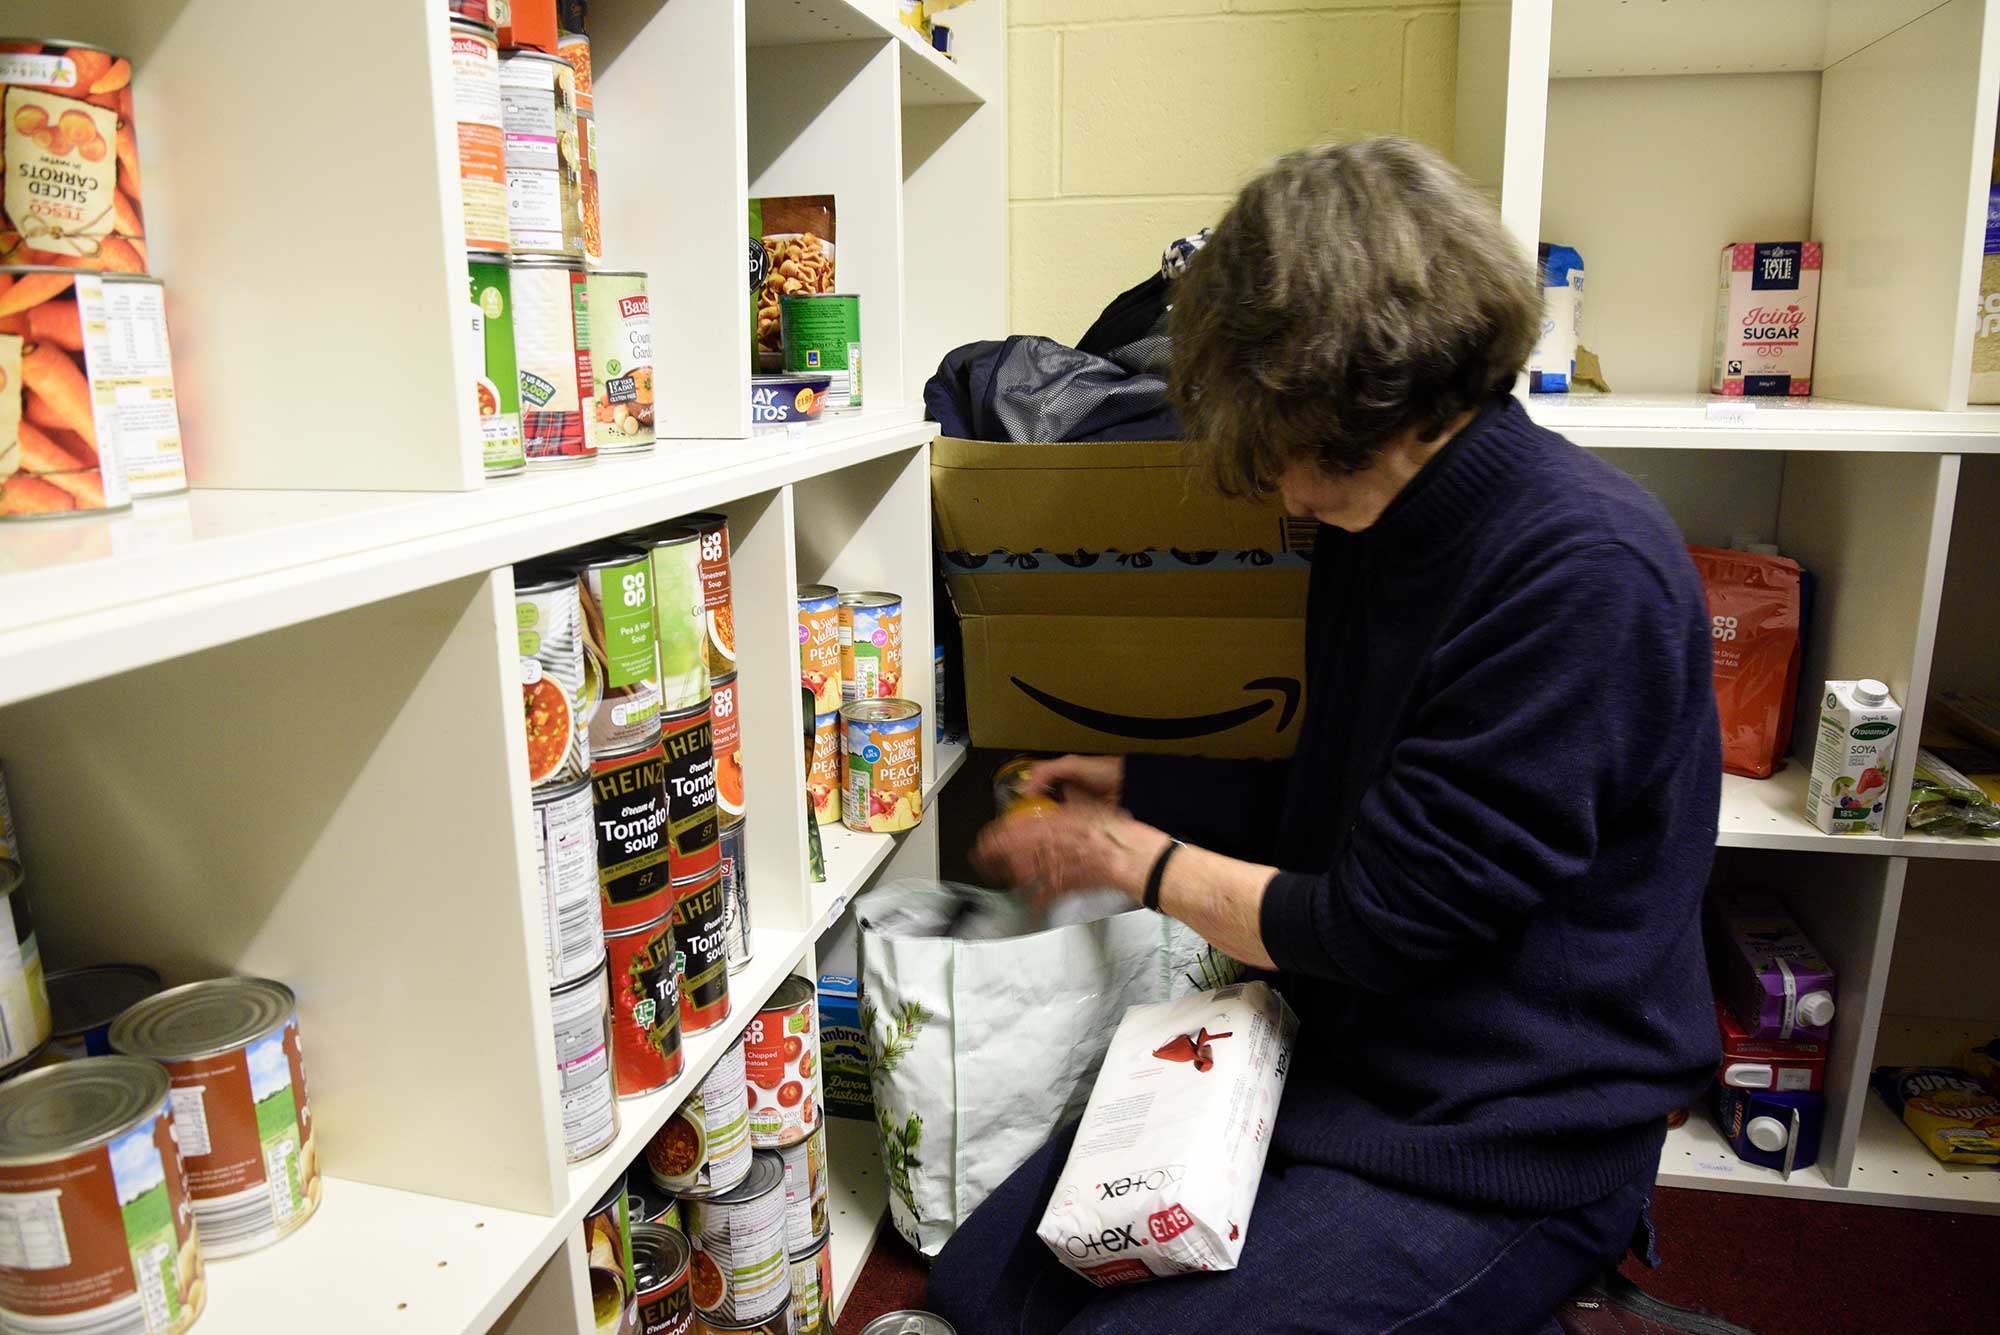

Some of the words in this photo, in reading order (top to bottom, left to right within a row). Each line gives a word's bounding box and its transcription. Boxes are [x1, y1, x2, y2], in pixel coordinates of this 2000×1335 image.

[19, 163, 98, 191] CARROTS
[28, 181, 87, 203] SLICED
[29, 203, 84, 222] TESCO
[1763, 257, 1793, 269] TATE
[1764, 269, 1792, 280] LYLE
[1742, 306, 1807, 330] Icing
[1743, 327, 1799, 340] SUGAR
[1712, 615, 1738, 629] co
[1720, 649, 1741, 660] Dried
[1725, 657, 1739, 667] Milk
[1852, 727, 1891, 736] Provamel
[892, 735, 916, 752] Sweet
[1851, 745, 1877, 755] SOYA
[884, 745, 919, 768] Valley
[880, 761, 921, 781] PEACH
[892, 778, 913, 788] SLICES
[600, 807, 667, 842] Tomato
[624, 831, 660, 854] soup
[639, 871, 654, 887] 57
[747, 1051, 778, 1060] Chopped
[829, 1075, 869, 1091] Devon
[1906, 1074, 1986, 1097] SUPER
[1150, 1206, 1191, 1239] £1.15
